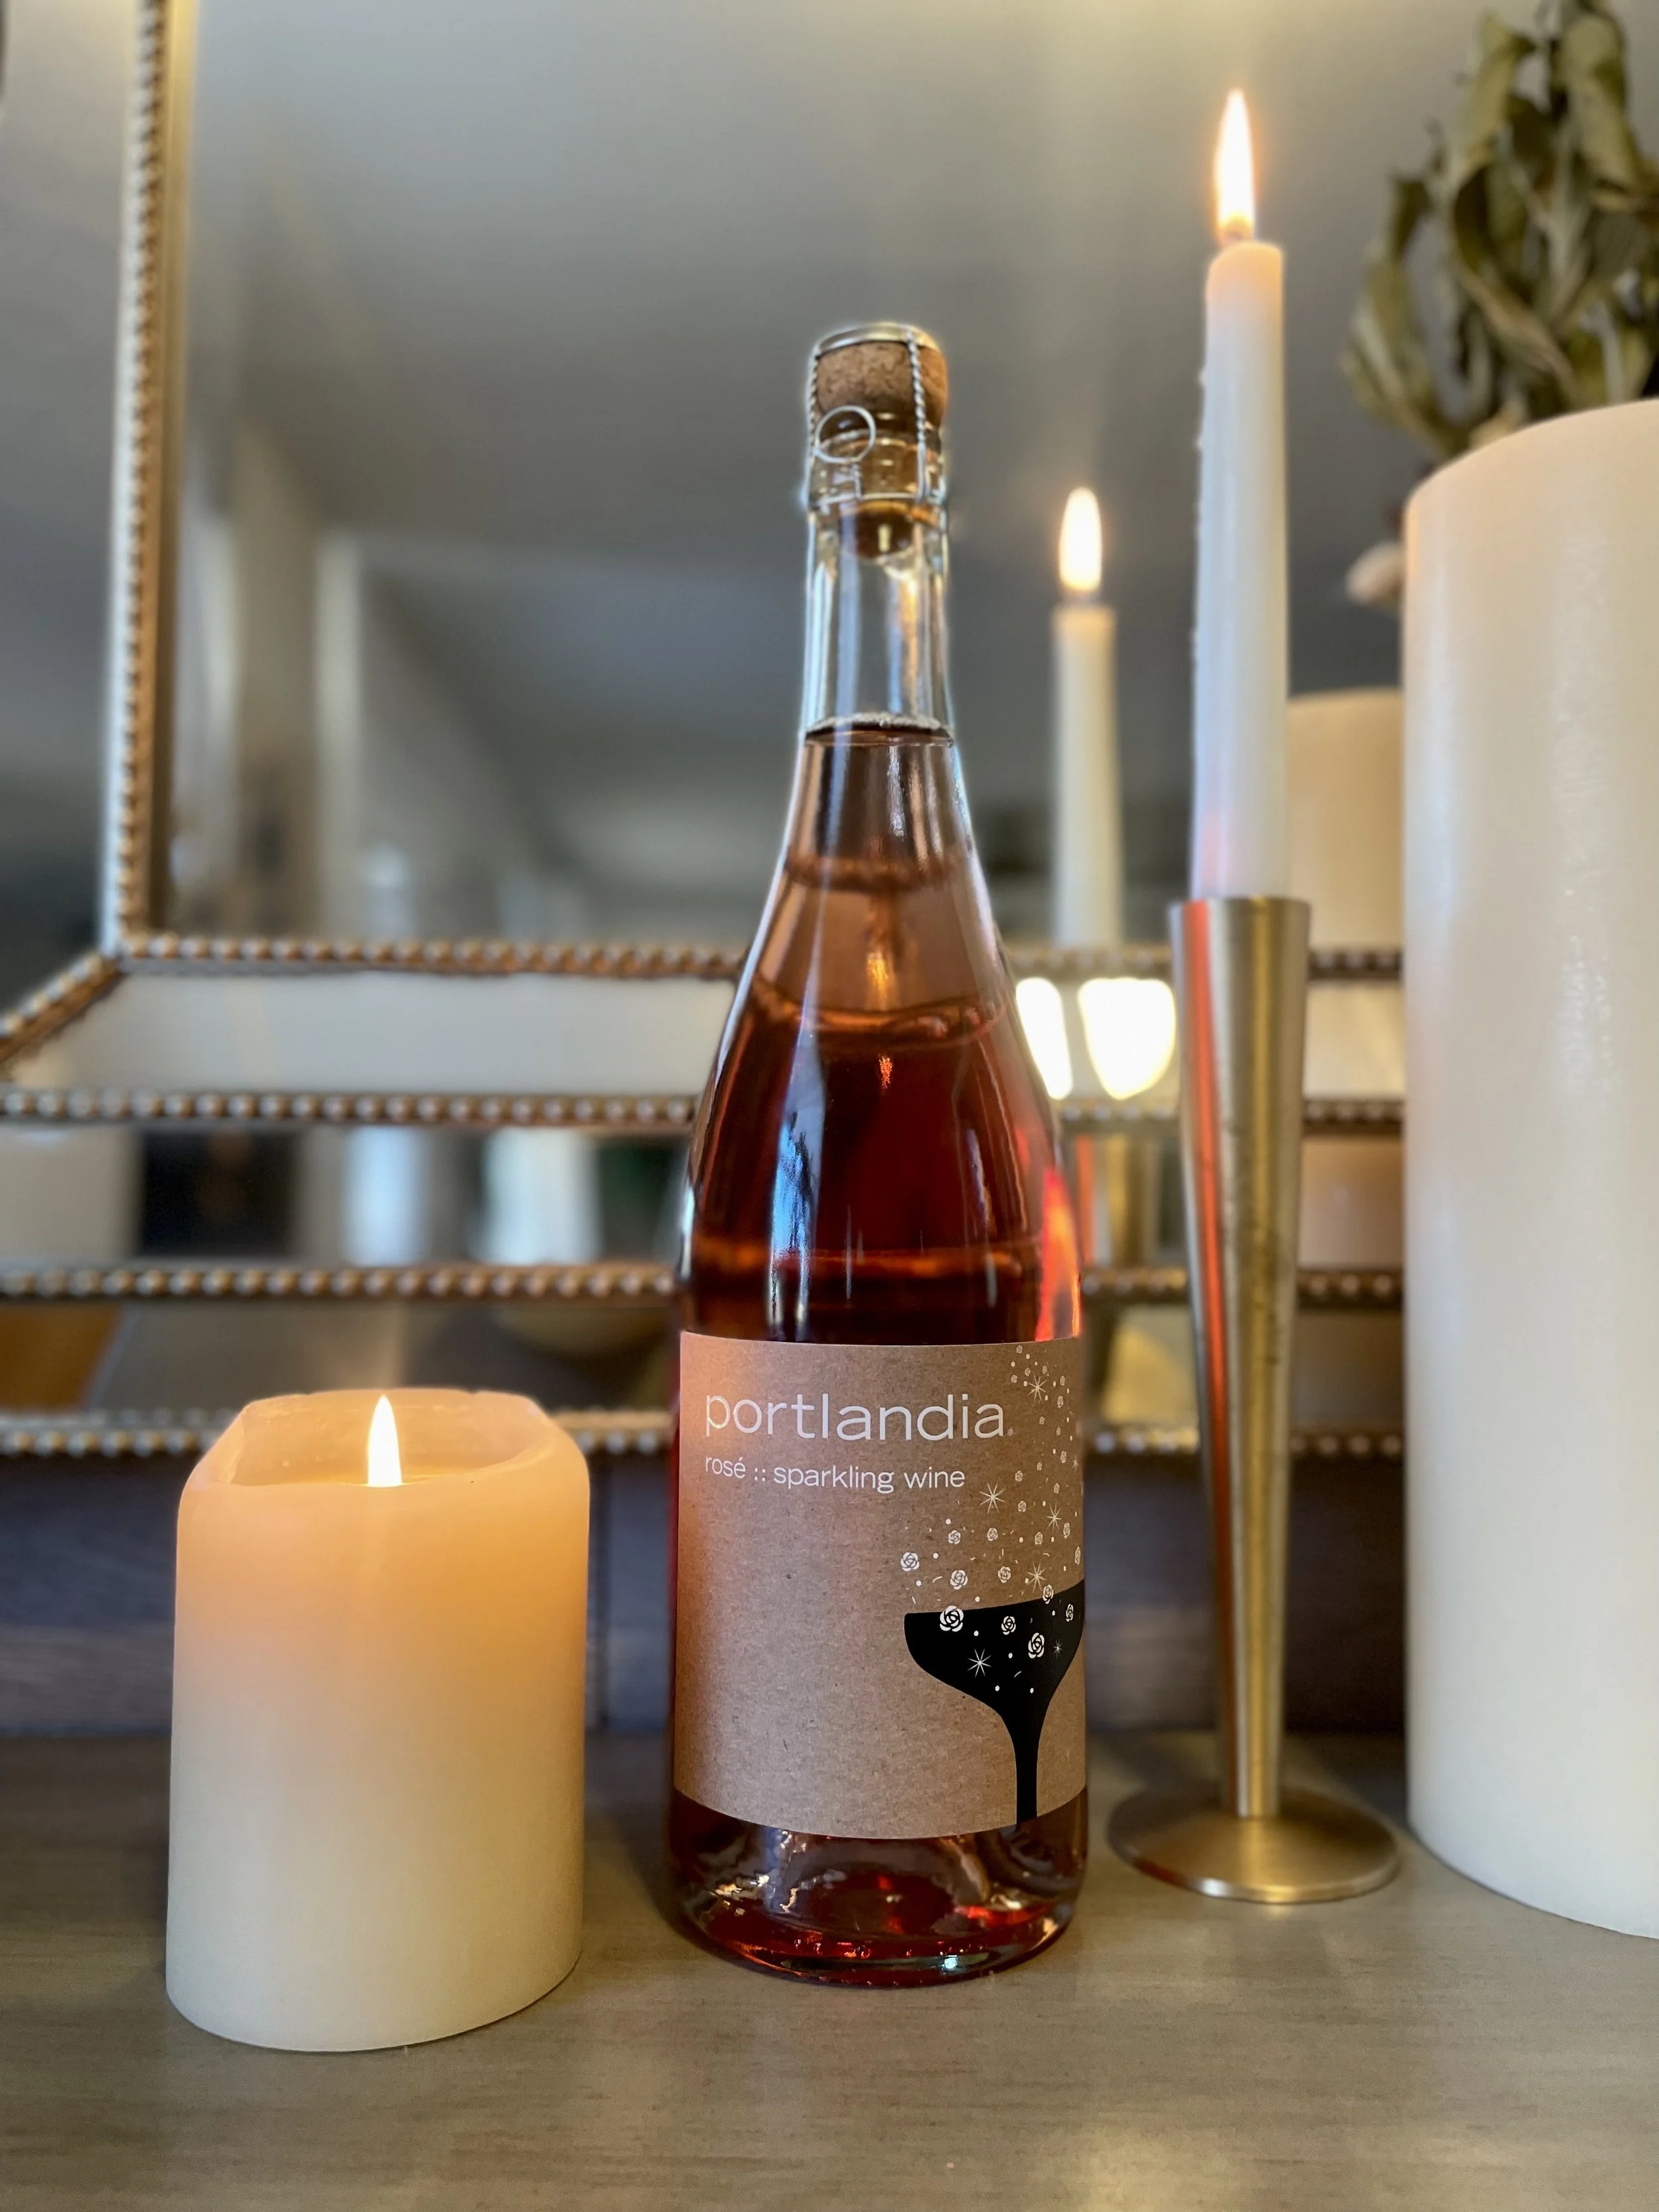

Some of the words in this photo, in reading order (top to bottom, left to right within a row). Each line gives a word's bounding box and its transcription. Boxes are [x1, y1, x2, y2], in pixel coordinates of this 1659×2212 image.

[705, 1393, 1004, 1440] portlandia
[705, 1456, 746, 1479] rosé
[773, 1465, 894, 1494] sparkling
[904, 1467, 966, 1489] wine
